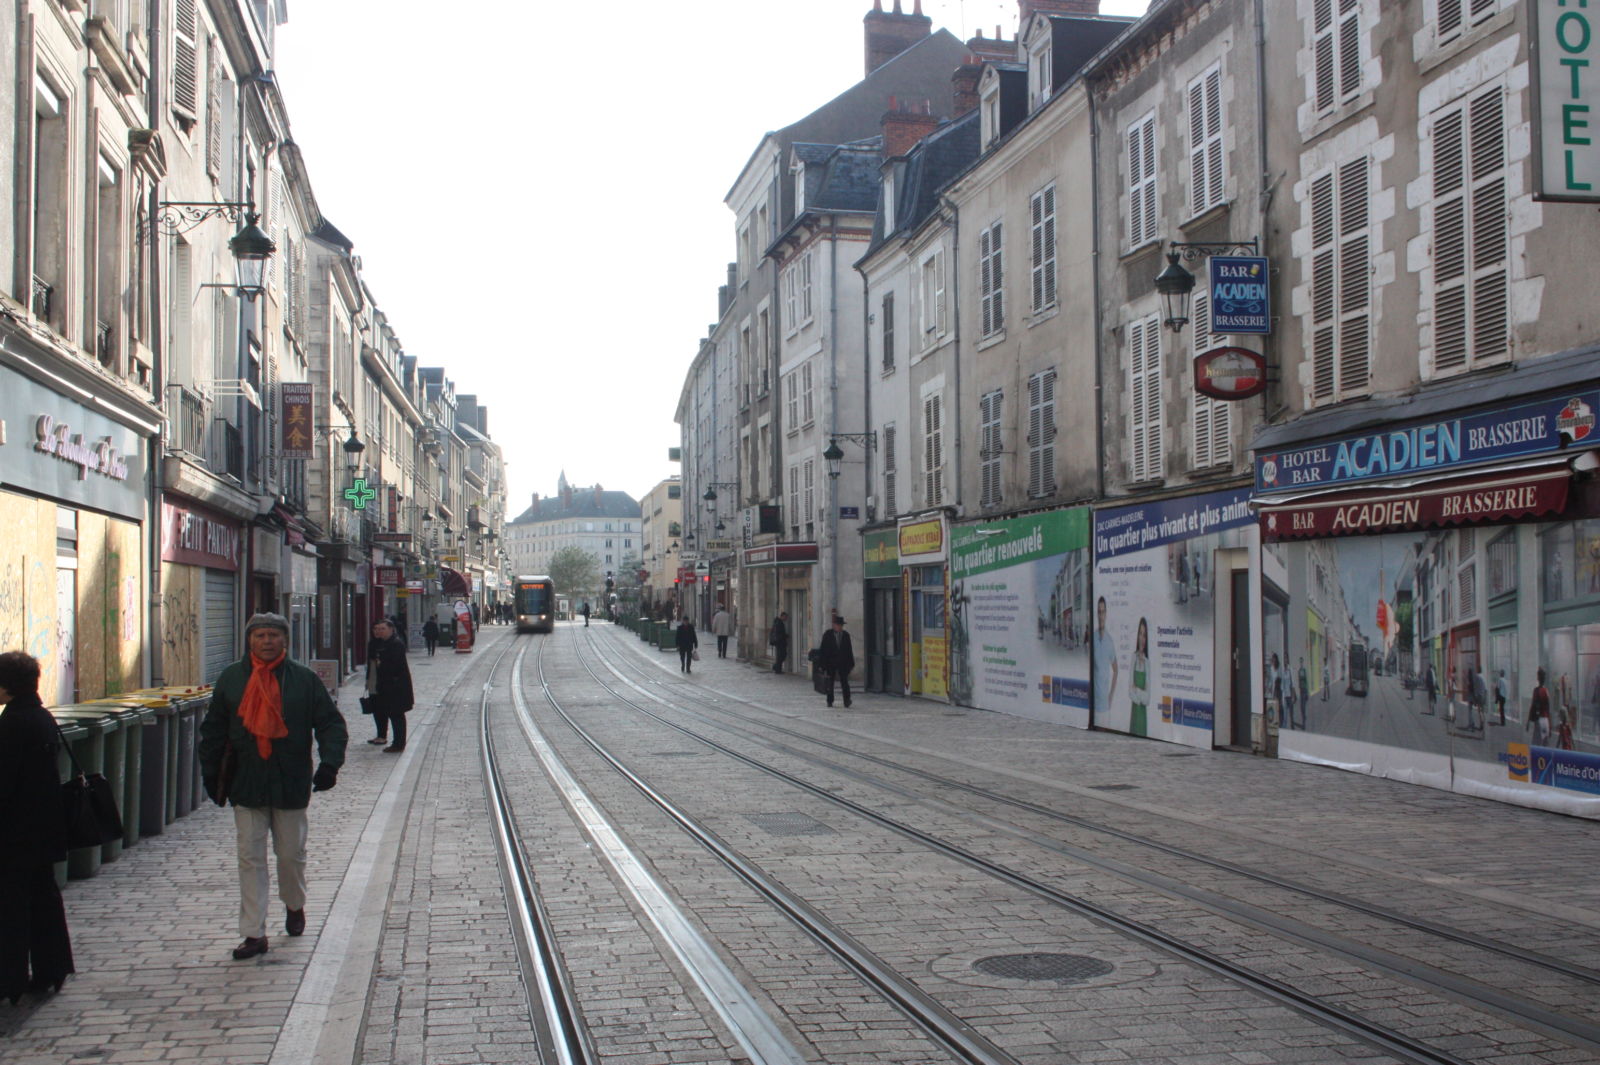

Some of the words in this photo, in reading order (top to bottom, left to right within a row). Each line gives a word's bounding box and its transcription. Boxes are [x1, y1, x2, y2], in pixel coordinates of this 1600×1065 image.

[1555, 0, 1592, 191] OTEL
[1219, 265, 1249, 278] BAR
[1214, 282, 1266, 300] ACADIEN
[1215, 315, 1266, 327] BRASSERIE
[283, 385, 312, 393] TRAITEUR
[284, 394, 310, 403] CHINOIS
[1283, 448, 1330, 468] HOTEL
[1332, 420, 1461, 480] ACADIEN
[1468, 415, 1547, 451] BRASSERIE
[1292, 466, 1321, 484] BAR
[1292, 512, 1314, 530] BAR
[1332, 500, 1420, 530] ACADIEN
[1442, 485, 1537, 518] BRASSERIE
[181, 512, 202, 551] PETIT
[1097, 535, 1108, 553] Un
[1109, 526, 1140, 555] quartier
[1141, 521, 1158, 548] plus
[1159, 514, 1186, 537] vivant
[1188, 510, 1198, 530] et
[1200, 504, 1220, 534] plus
[953, 552, 963, 572] Un
[964, 542, 996, 576] quartier
[998, 525, 1043, 561] renouvelé
[1556, 763, 1581, 778] Mairie
